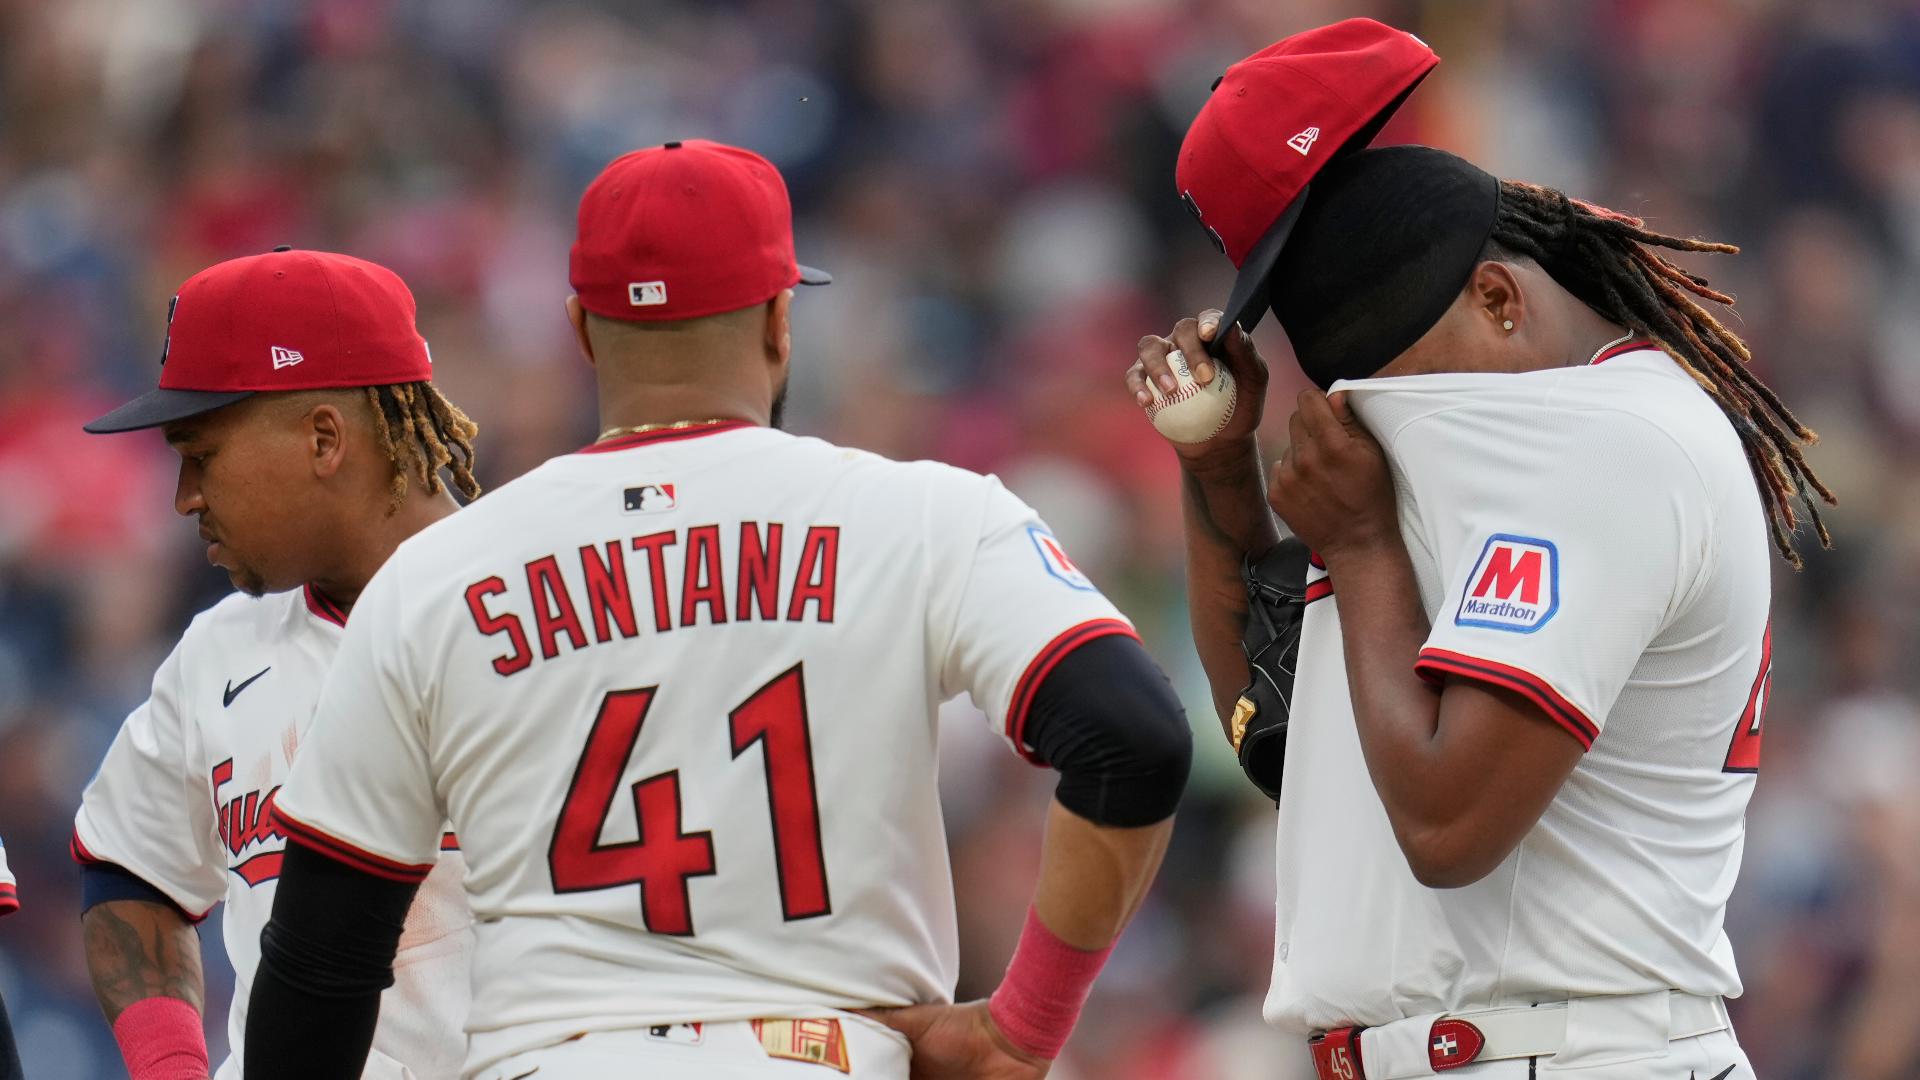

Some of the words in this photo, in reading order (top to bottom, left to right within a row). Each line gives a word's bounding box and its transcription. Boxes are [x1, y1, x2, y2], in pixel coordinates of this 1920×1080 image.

[464, 521, 840, 677] SANTANA
[1471, 546, 1542, 605] M
[1463, 599, 1537, 621] Marathon
[547, 660, 832, 937] 41
[1330, 1047, 1353, 1080] 45
